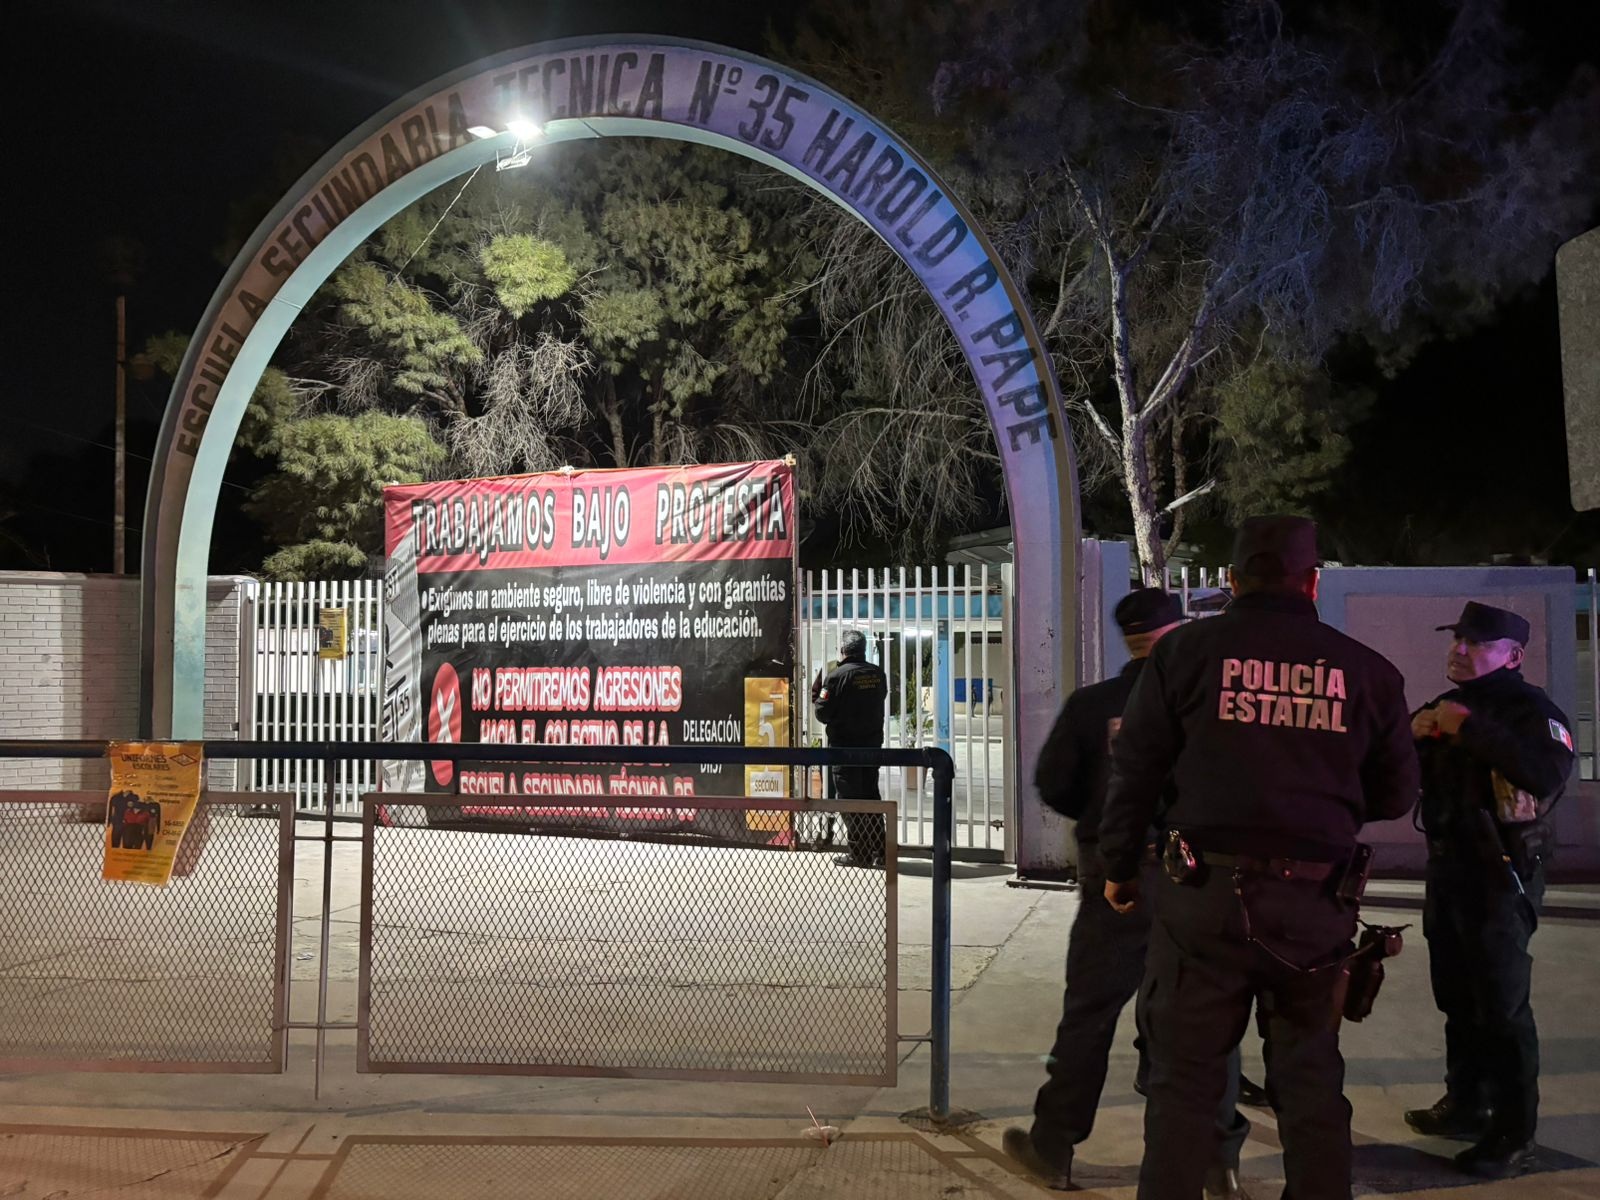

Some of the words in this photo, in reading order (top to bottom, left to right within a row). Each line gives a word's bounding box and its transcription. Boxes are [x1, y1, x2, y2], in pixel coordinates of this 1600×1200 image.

[493, 52, 666, 119] TECNICA
[738, 75, 809, 151] 35
[262, 92, 473, 281] SECUNDARIA
[802, 108, 970, 268] HAROLD
[943, 258, 999, 321] R.
[175, 289, 267, 457] ESCUELA
[970, 310, 1059, 452] PAPE
[411, 489, 555, 565] TRABAJAMOS
[572, 484, 632, 561] BAJO
[655, 478, 788, 546] PROTESTA
[428, 585, 474, 617] Exigimos
[475, 588, 489, 610] un
[491, 582, 541, 609] ambiente
[543, 583, 584, 614] seguro,
[587, 579, 612, 606] libre
[615, 578, 630, 605] de
[632, 576, 686, 604] violencia
[688, 581, 696, 610] y
[699, 580, 722, 602] con
[724, 573, 786, 610] garantías
[427, 618, 460, 650] plenas
[461, 621, 486, 649] para
[488, 615, 498, 642] el
[500, 614, 546, 648] ejercicio
[549, 613, 563, 641] de
[565, 613, 583, 641] los
[585, 611, 659, 647] trabajadores
[661, 611, 676, 639] de
[679, 611, 691, 639] la
[693, 609, 763, 639] educación.
[472, 668, 492, 709] NO
[495, 667, 590, 710] PERMITIREMOS
[593, 667, 682, 710] AGRESIONES
[1222, 658, 1347, 700] POLICÍA
[683, 714, 741, 743] DELEGACIÓN
[1218, 690, 1347, 733] ESTATAL
[754, 777, 779, 792] SECCIÓN
